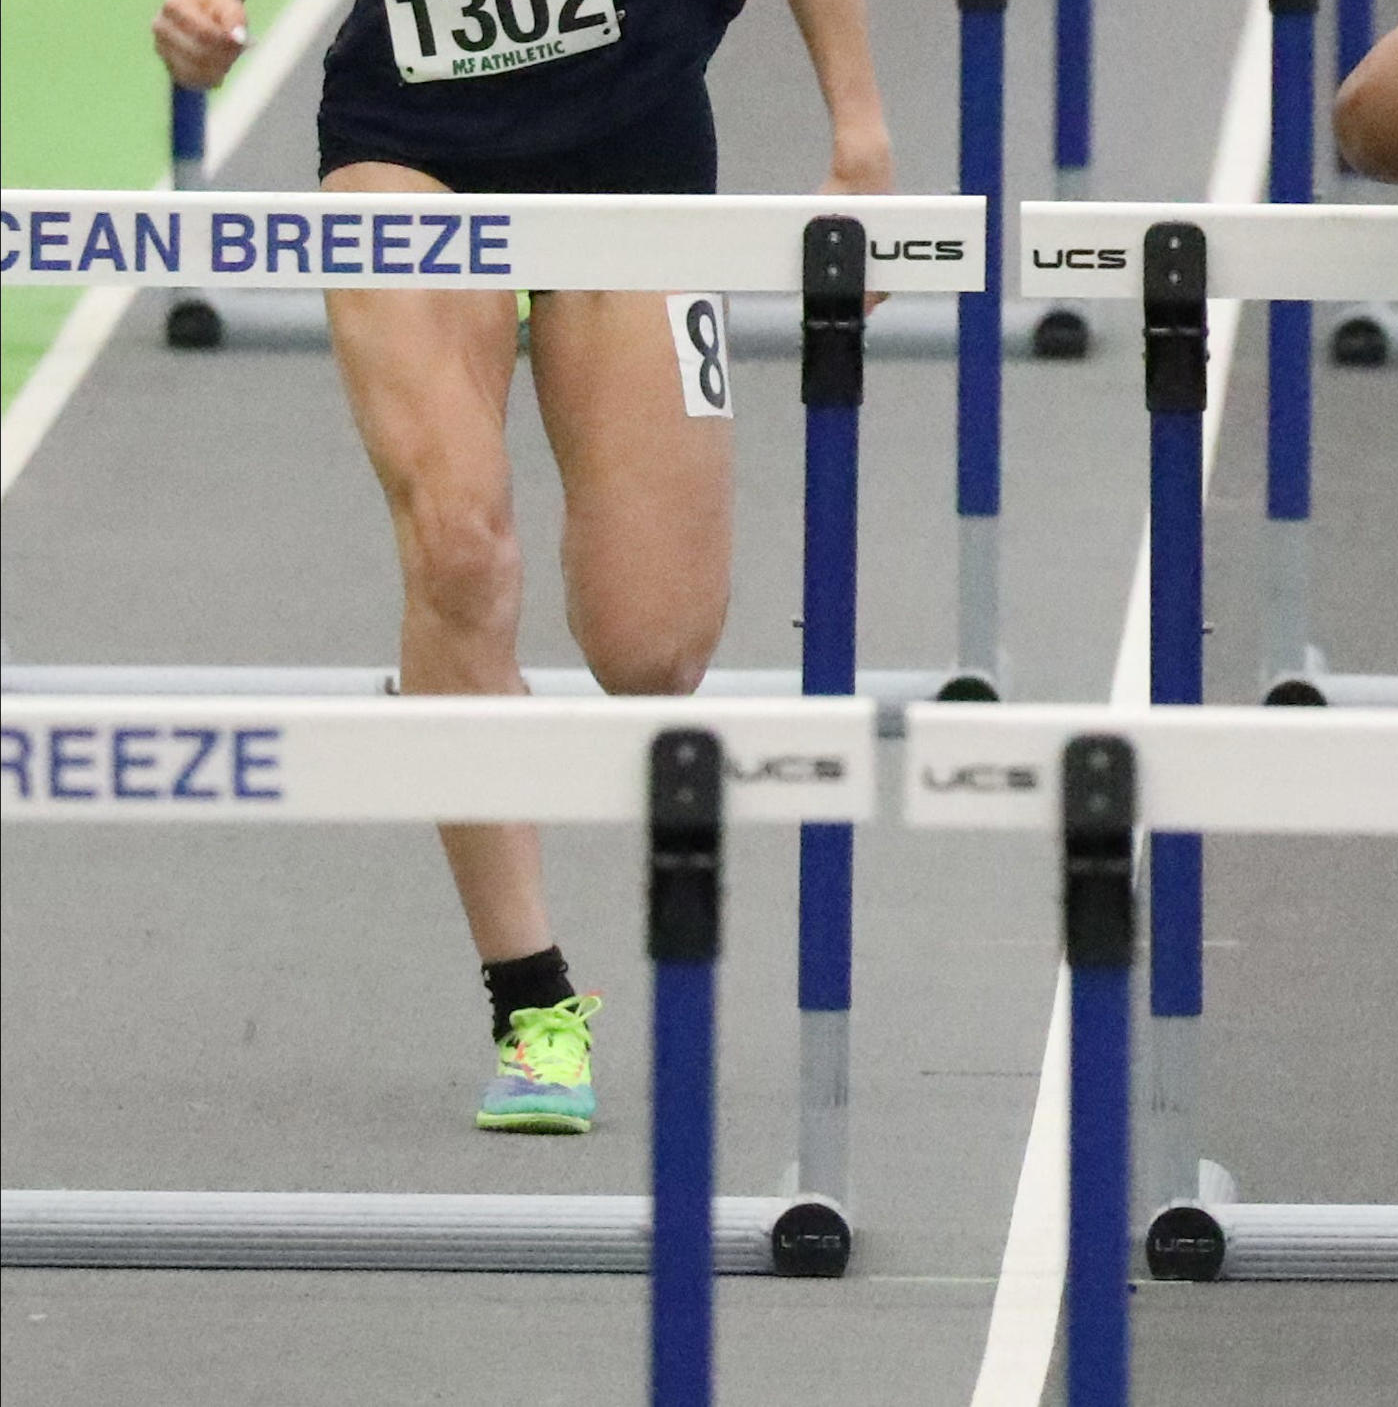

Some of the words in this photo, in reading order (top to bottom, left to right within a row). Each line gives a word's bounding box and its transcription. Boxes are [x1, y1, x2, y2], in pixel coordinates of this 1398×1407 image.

[480, 40, 566, 71] ATHLETIC
[1, 210, 181, 273] EAN
[211, 214, 512, 275] BREEZE
[870, 240, 966, 261] UCS
[1033, 248, 1127, 270] UCS
[686, 299, 726, 410] 8
[0, 727, 283, 799] REEZE
[731, 756, 845, 782] UCS
[922, 763, 1039, 791] UCS
